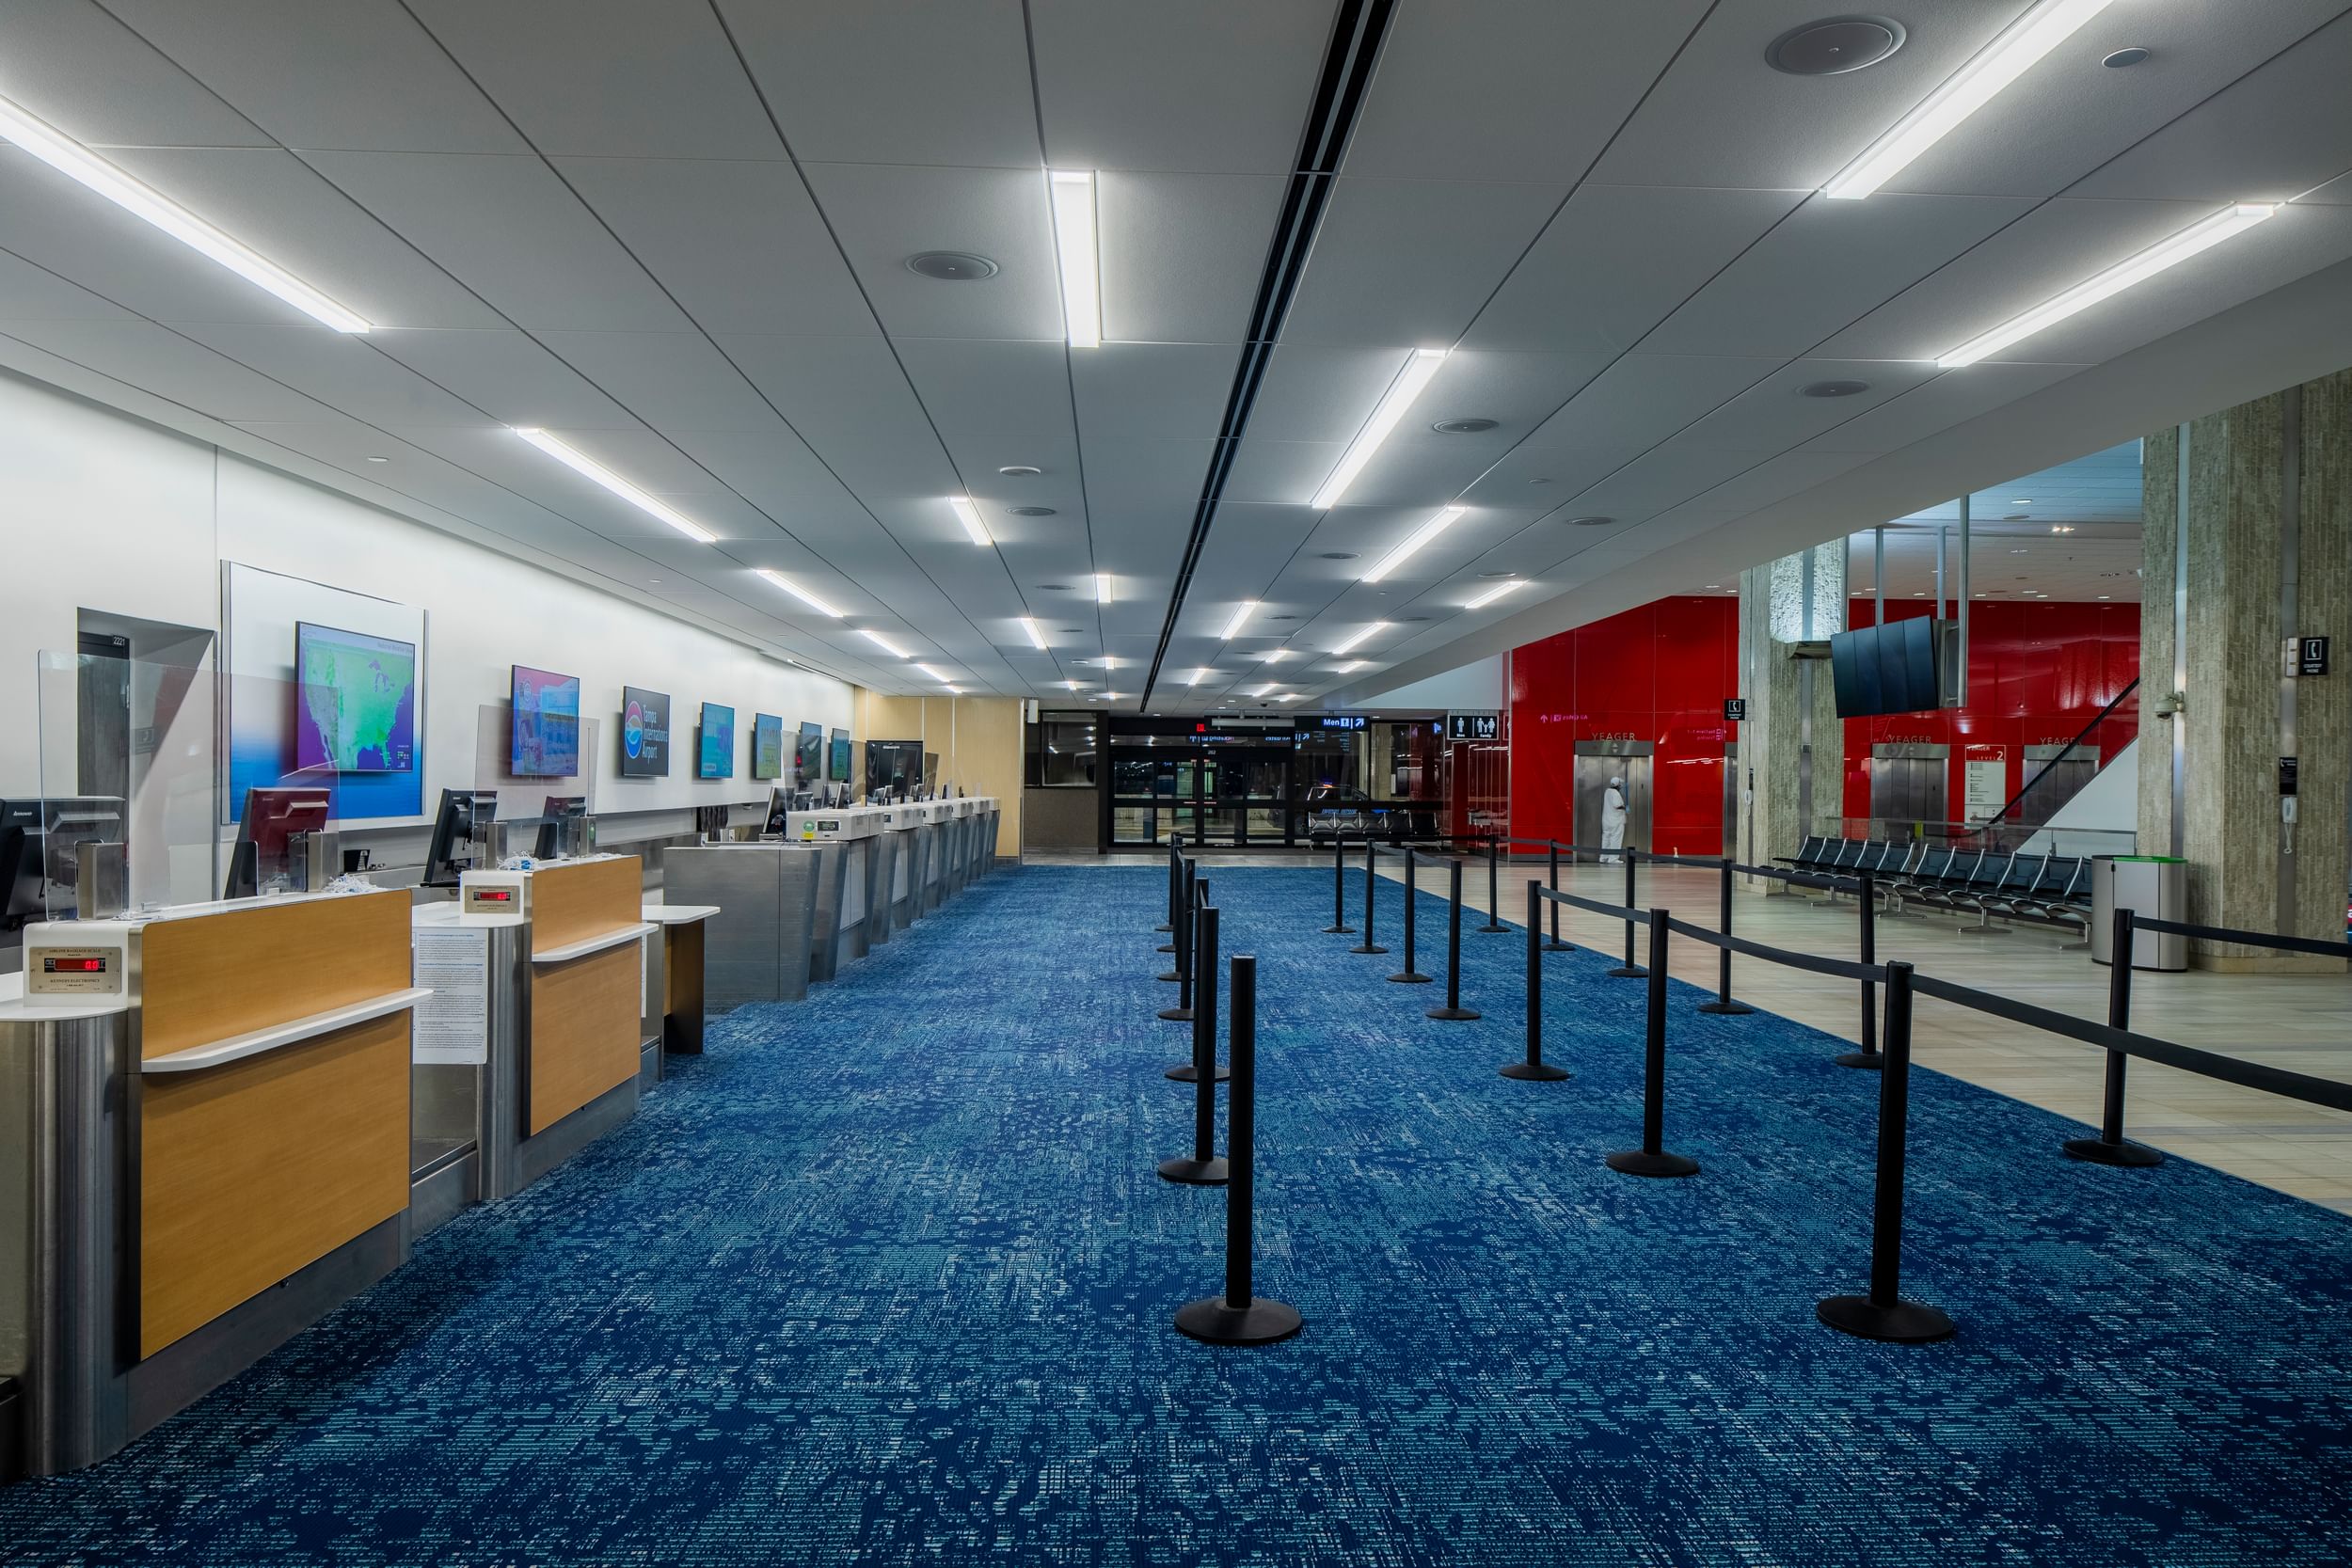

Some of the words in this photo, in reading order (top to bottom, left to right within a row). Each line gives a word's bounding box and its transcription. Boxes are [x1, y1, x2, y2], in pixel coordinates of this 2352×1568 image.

[113, 636, 125, 646] 2221
[643, 705, 657, 728] Tampa
[1591, 733, 1635, 741] YEAGER
[1889, 736, 1931, 744] YEAGER
[642, 741, 658, 765] Airport
[1996, 751, 2004, 761] 2
